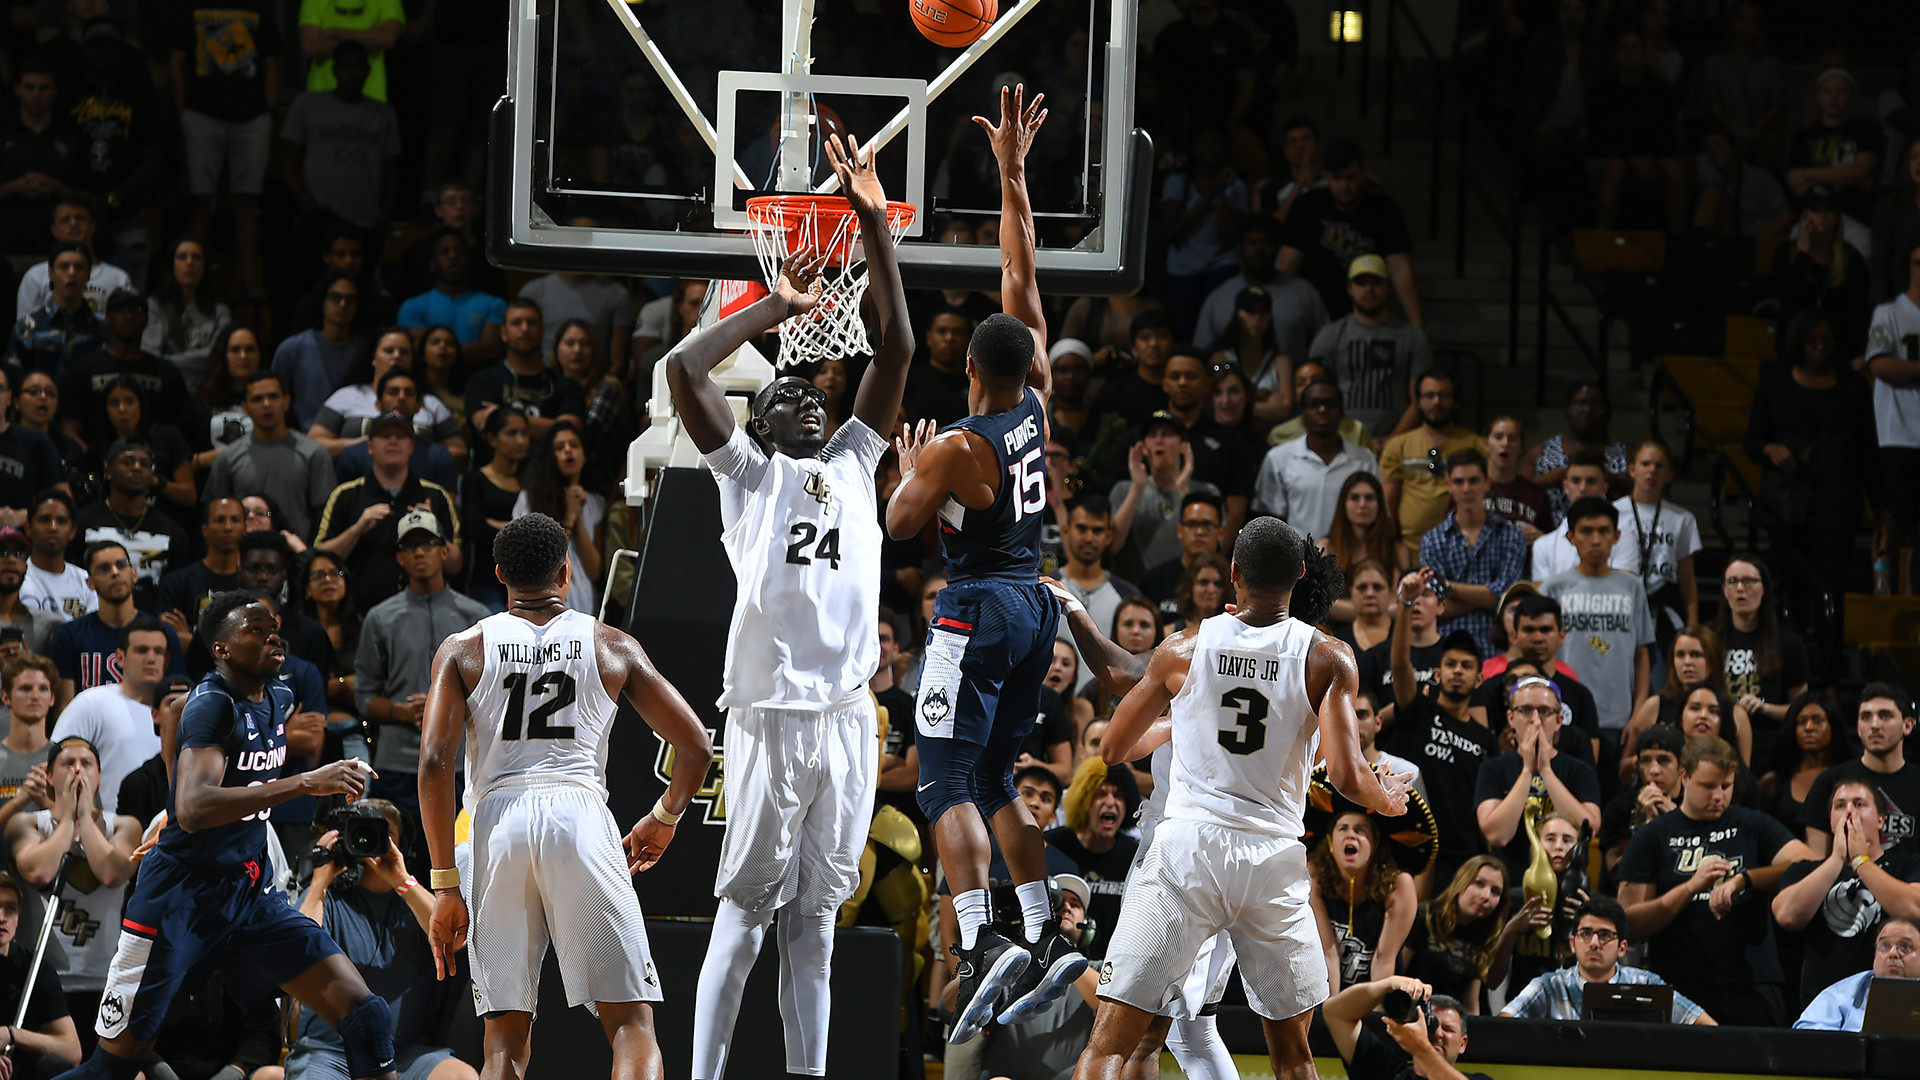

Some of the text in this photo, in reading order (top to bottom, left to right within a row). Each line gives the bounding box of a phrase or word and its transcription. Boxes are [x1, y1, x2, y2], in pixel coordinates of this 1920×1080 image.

[914, 0, 948, 25] ELITE
[1003, 414, 1038, 456] PURVIS
[1008, 445, 1047, 524] 15
[785, 521, 841, 571] 24
[1561, 593, 1632, 614] KNIGHTS
[497, 639, 582, 665] WILLIAMS JR
[1217, 654, 1279, 682] DAVIS JR
[501, 670, 577, 741] 12
[1217, 686, 1271, 756] 3
[237, 745, 287, 771] UCONN
[1669, 828, 1738, 847] 2016 2017
